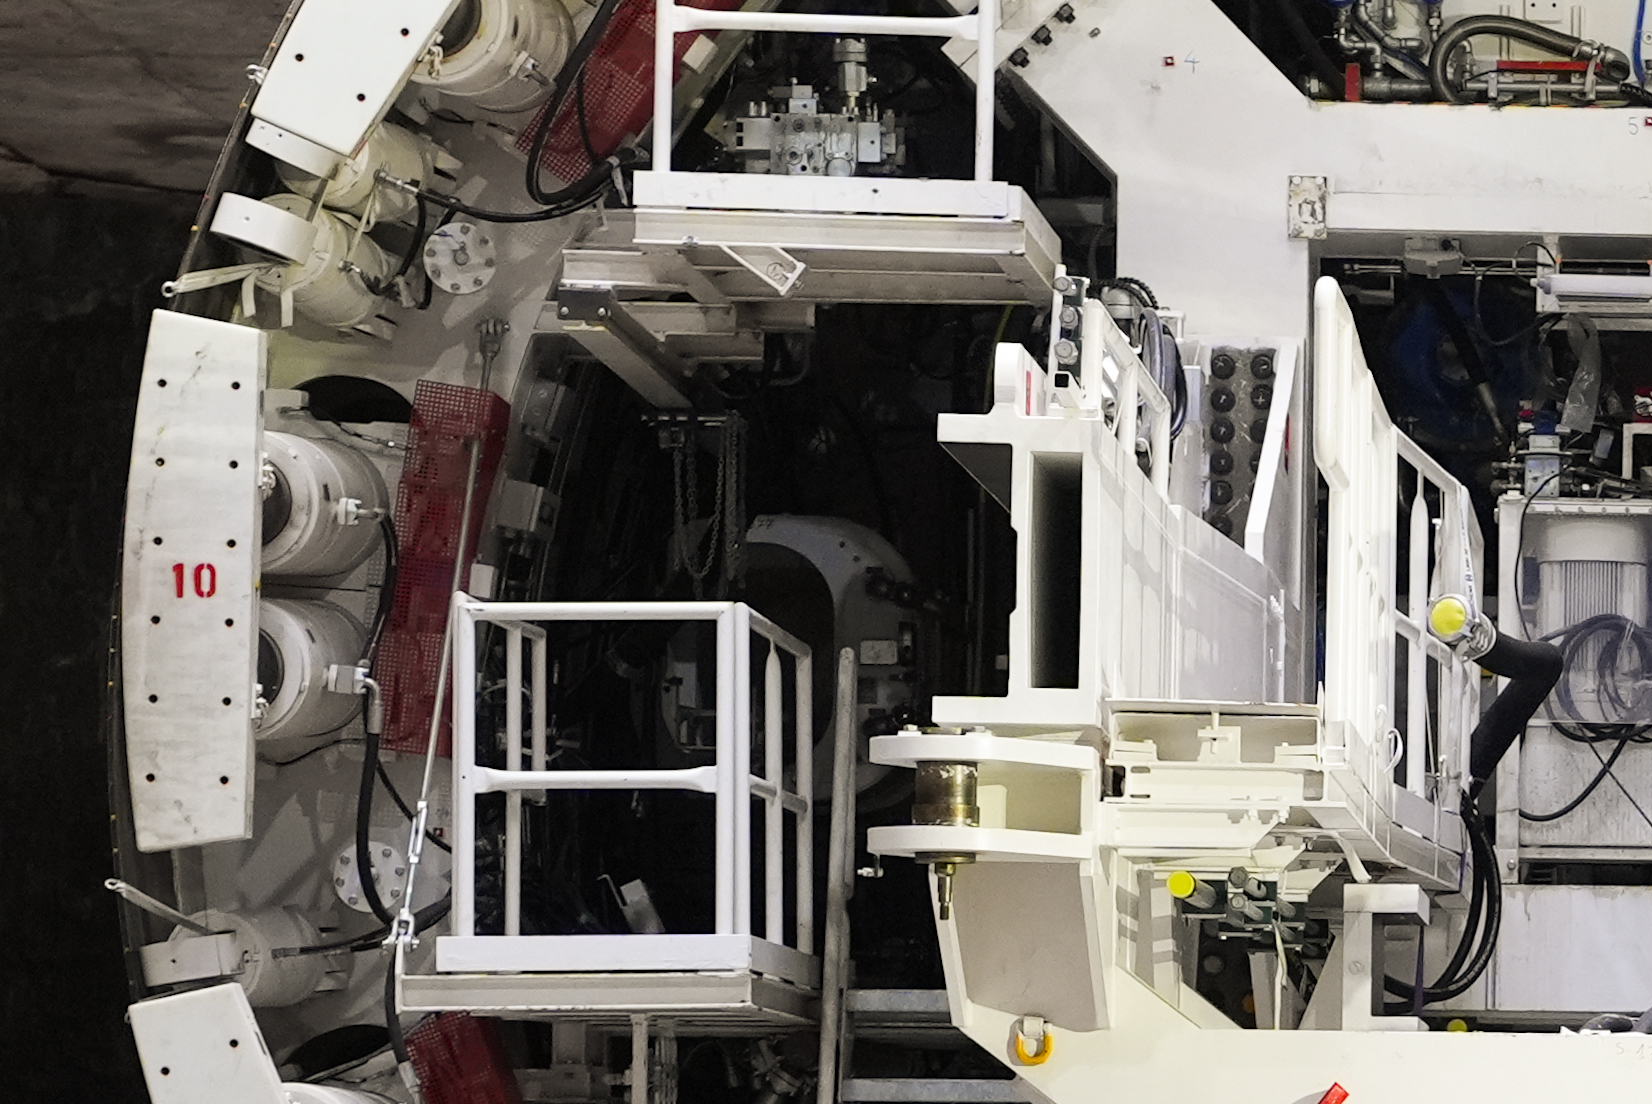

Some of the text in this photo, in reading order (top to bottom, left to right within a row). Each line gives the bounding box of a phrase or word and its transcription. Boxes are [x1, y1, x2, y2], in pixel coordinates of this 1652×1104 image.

[1183, 49, 1200, 74] 4
[1628, 116, 1639, 136] 5
[172, 563, 217, 599] 10
